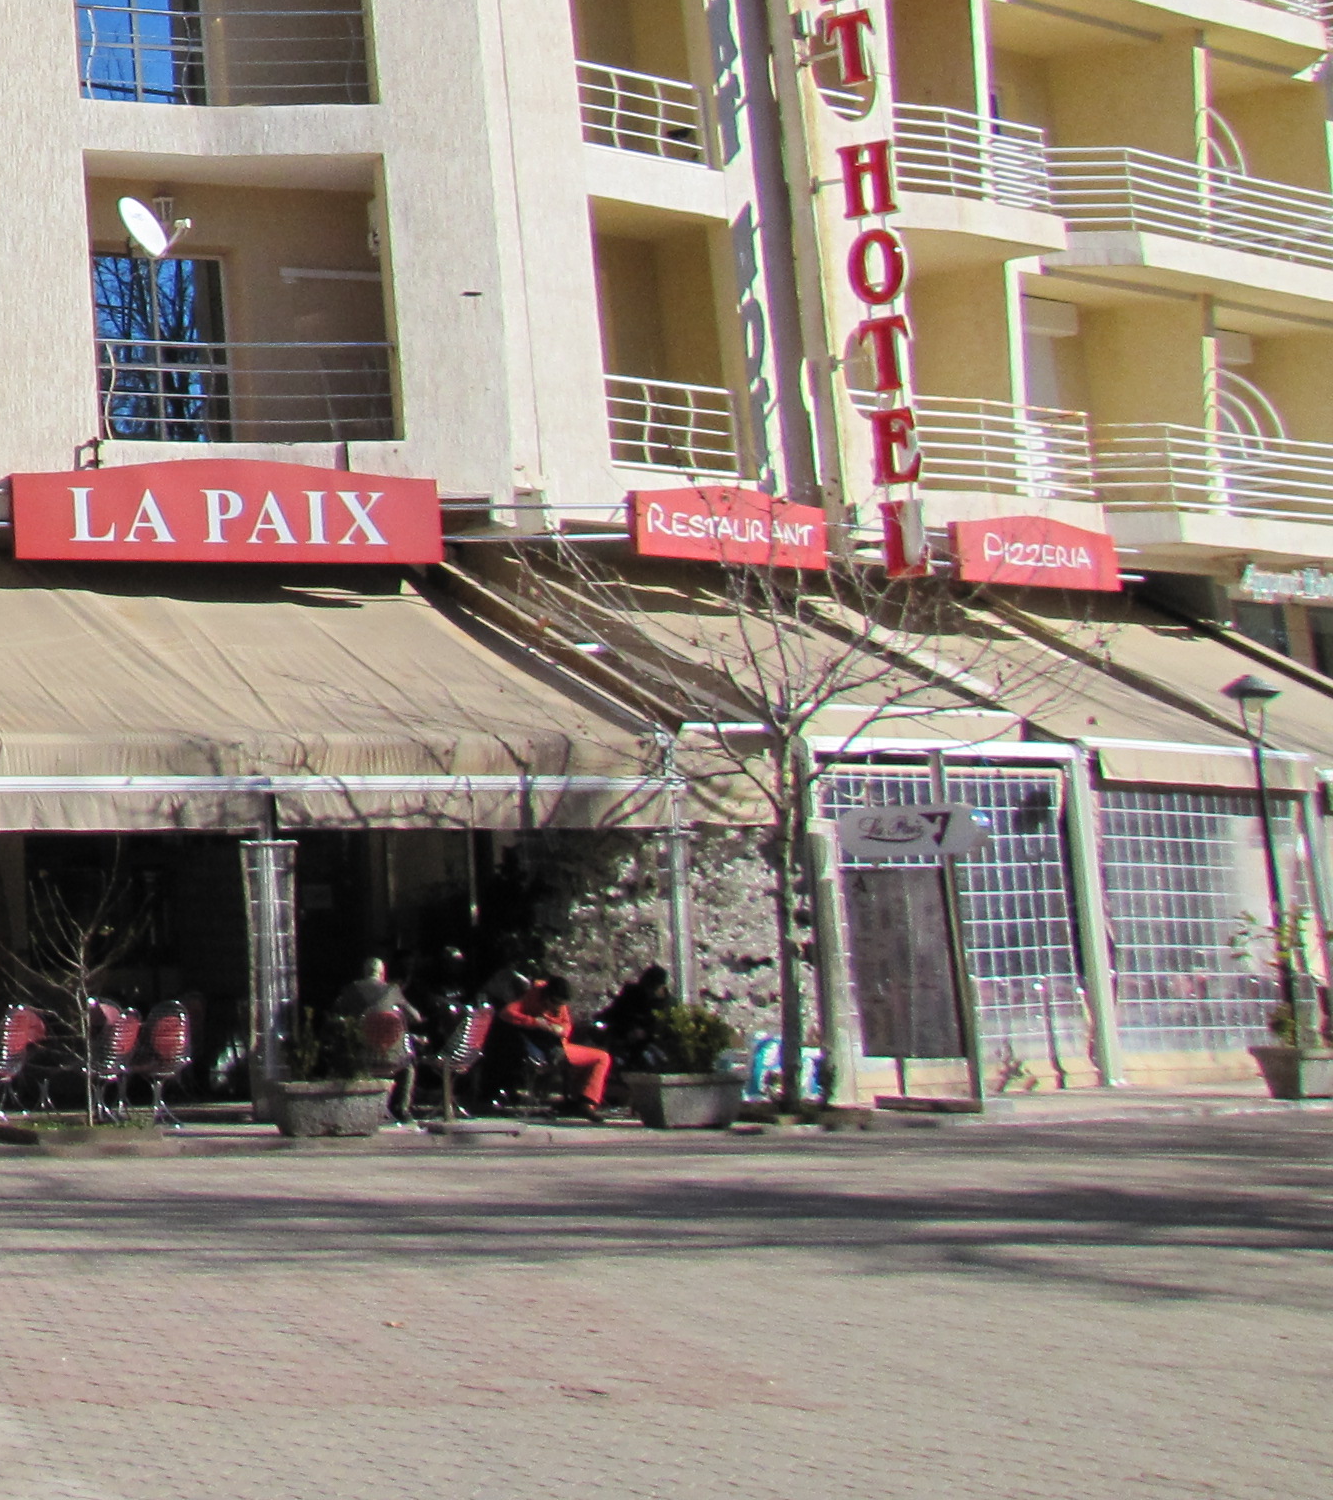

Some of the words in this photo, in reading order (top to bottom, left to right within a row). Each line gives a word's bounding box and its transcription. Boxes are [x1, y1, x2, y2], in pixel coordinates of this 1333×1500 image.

[836, 139, 931, 578] HOTEL
[66, 487, 177, 543] LA
[199, 488, 389, 546] PAIX
[646, 502, 814, 547] RESTAURANT
[983, 532, 1092, 569] PIZZERIA
